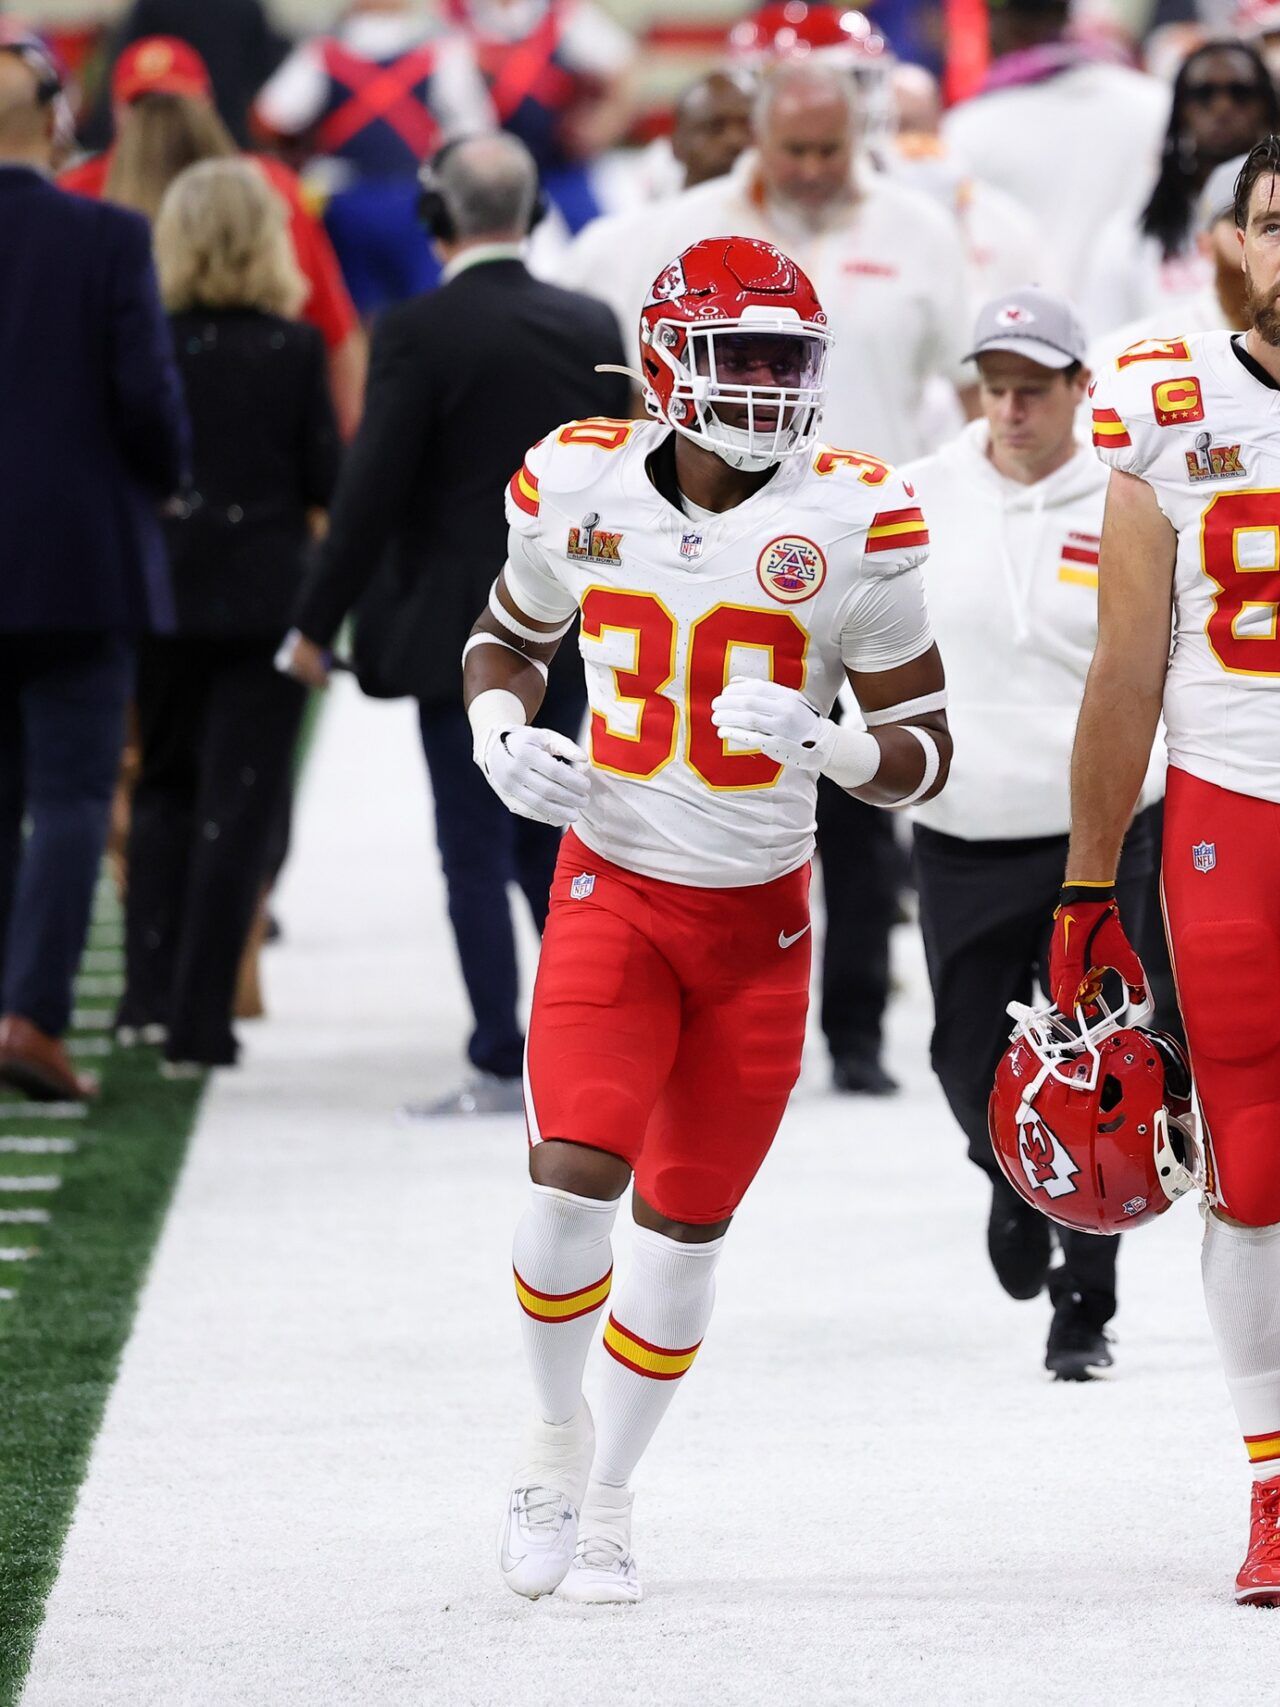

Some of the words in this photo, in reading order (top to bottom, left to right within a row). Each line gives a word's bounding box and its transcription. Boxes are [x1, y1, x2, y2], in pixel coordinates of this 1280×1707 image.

[1114, 336, 1193, 373] 7
[1155, 380, 1199, 412] C
[556, 417, 634, 452] 0
[812, 445, 893, 487] 3
[1185, 438, 1245, 476] LIX
[1195, 473, 1219, 481] SUPER
[567, 518, 624, 559] LIX
[681, 543, 698, 555] NFL
[766, 543, 816, 581] A
[580, 584, 811, 792] 30
[1197, 855, 1213, 867] NFL
